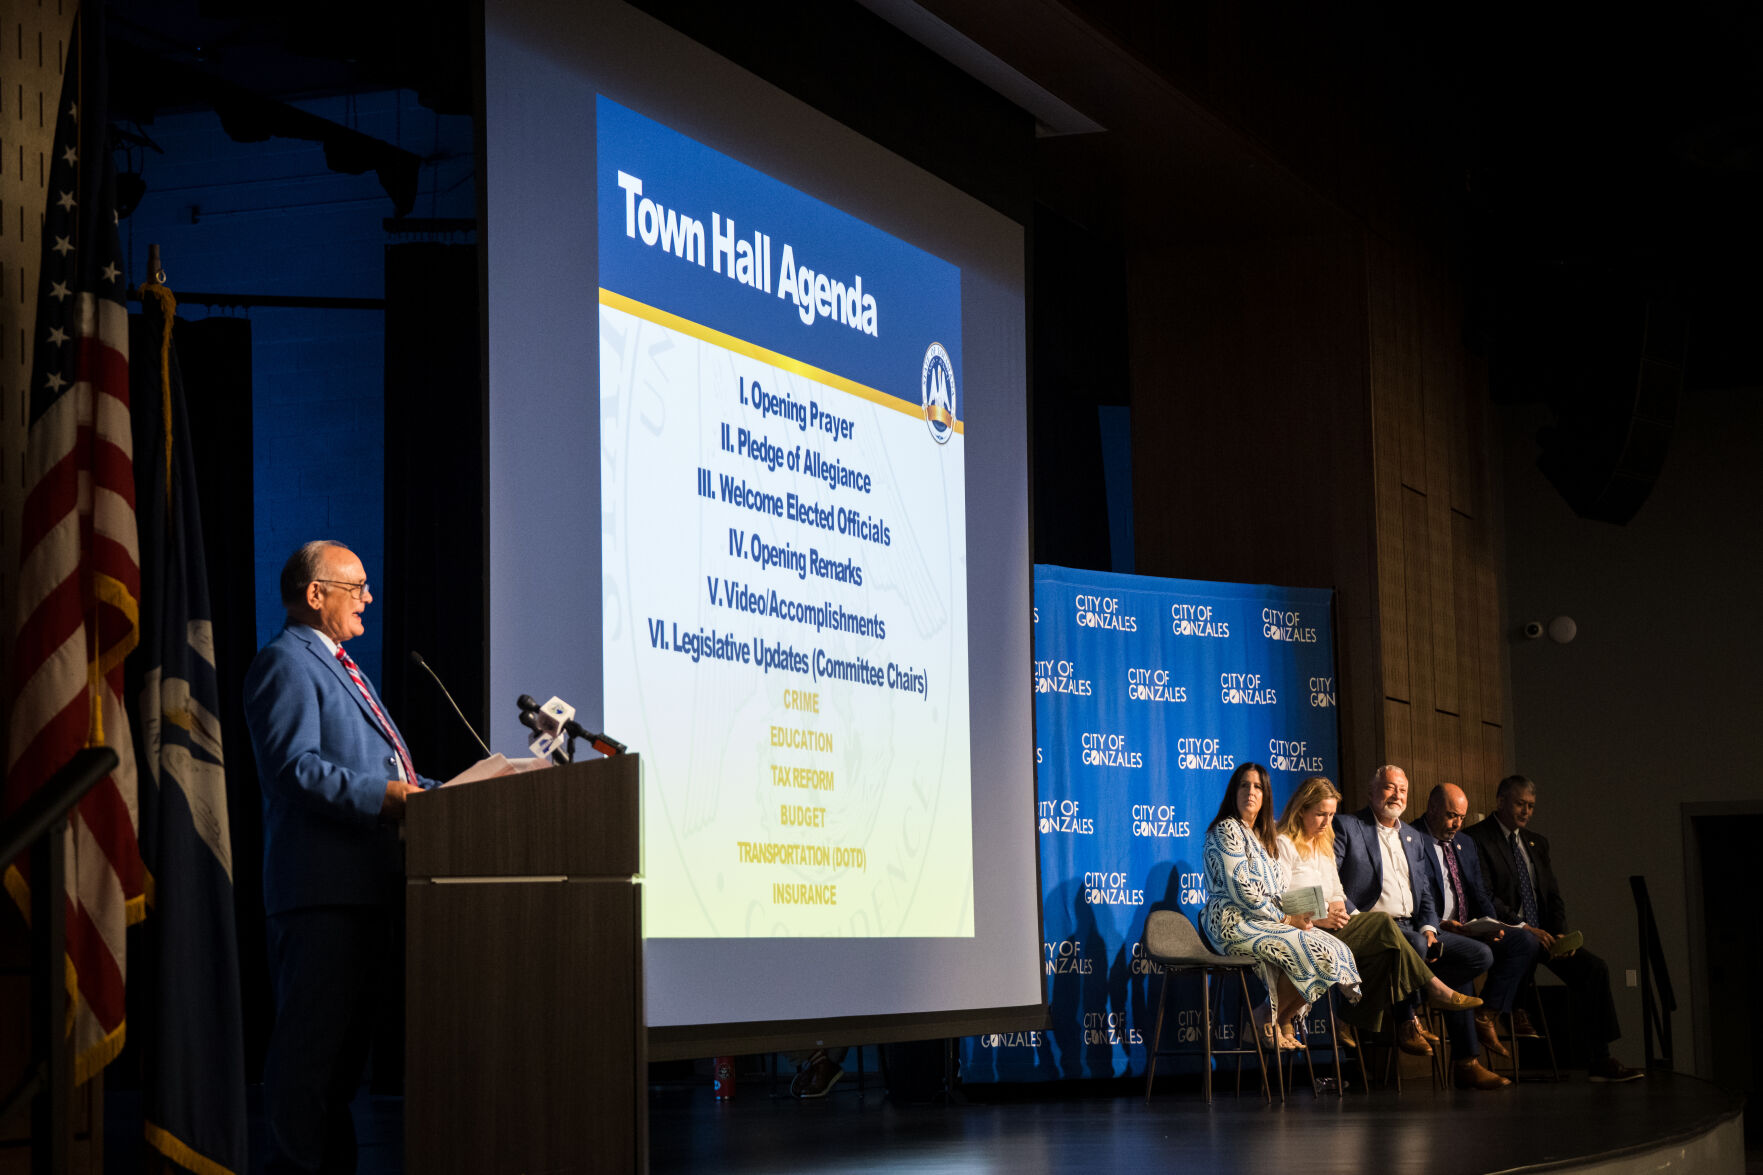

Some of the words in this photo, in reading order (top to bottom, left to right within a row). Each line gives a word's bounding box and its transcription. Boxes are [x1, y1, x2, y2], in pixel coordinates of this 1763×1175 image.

[617, 169, 706, 268] Town
[711, 210, 772, 294] Hall
[777, 242, 879, 338] Agenda
[739, 376, 749, 405] I.
[751, 380, 807, 432] Opening
[809, 400, 855, 442] Prayer
[721, 422, 735, 453] II.
[737, 427, 784, 472] Pledge
[787, 445, 801, 472] of
[803, 449, 872, 494] Allegiance
[697, 467, 716, 500] III.
[719, 473, 784, 518] Welcome
[786, 492, 835, 531] Elected
[837, 507, 891, 547] Officials
[729, 527, 749, 559] IV.
[750, 533, 806, 580] Opening
[810, 548, 863, 587] Remarks
[707, 575, 723, 607] V.
[724, 579, 886, 640] Video/Accomplishments
[1075, 594, 1101, 612] CITY
[1102, 597, 1118, 614] OF
[1171, 603, 1196, 620] CITY
[1197, 605, 1213, 621] OF
[1076, 611, 1137, 632] GONZALES
[1262, 607, 1284, 625] CITY
[1285, 611, 1300, 626] OF
[1172, 620, 1230, 638] GONZALES
[1263, 623, 1317, 643] GONZALES
[648, 617, 669, 650] VI.
[672, 622, 751, 663] Legislative
[753, 636, 809, 674] Updates
[812, 647, 885, 687] (Committee
[887, 661, 928, 702] Chairs)
[1057, 660, 1074, 678] OF
[1128, 668, 1151, 684] CITY
[1153, 669, 1170, 686] OF
[1221, 673, 1246, 689] CITY
[1246, 674, 1261, 689] OF
[1309, 677, 1332, 692] CITY
[783, 688, 820, 714] CRIME
[1128, 684, 1187, 703] GONZALES
[1221, 688, 1277, 706] GONZALES
[770, 725, 834, 753] EDUCATION
[1081, 732, 1106, 749] CITY
[1108, 734, 1125, 751] OF
[1177, 738, 1202, 754] CITY
[1202, 738, 1220, 754] OF
[1269, 738, 1289, 755] CITY
[1290, 741, 1307, 757] OF
[1082, 749, 1143, 768] GONZALES
[1178, 754, 1235, 771] GONZALES
[1269, 754, 1324, 772] GONZALES
[770, 764, 791, 787] TAX
[792, 767, 835, 792] REFORM
[780, 804, 827, 828] BUDGET
[1038, 799, 1057, 818] ITY
[1060, 800, 1079, 817] OF
[1132, 804, 1156, 821] CITY
[1157, 805, 1176, 821] OF
[1038, 816, 1094, 835] ONZALES
[1132, 821, 1190, 838] GONZALES
[737, 841, 830, 867] TRANSPORTATION
[832, 847, 867, 873] (DOTD)
[1084, 872, 1108, 888] CITY
[1109, 872, 1127, 888] OF
[1180, 872, 1205, 888] CITY
[773, 883, 838, 905] INSURANCE
[1084, 888, 1144, 905] GONZALES
[1058, 940, 1081, 957] OF
[1084, 1013, 1105, 1030] CITY
[1108, 1012, 1125, 1029] OF
[1178, 1009, 1202, 1026] CITY
[981, 1030, 1042, 1048] GONZALES
[1084, 1029, 1144, 1046] GONZALES
